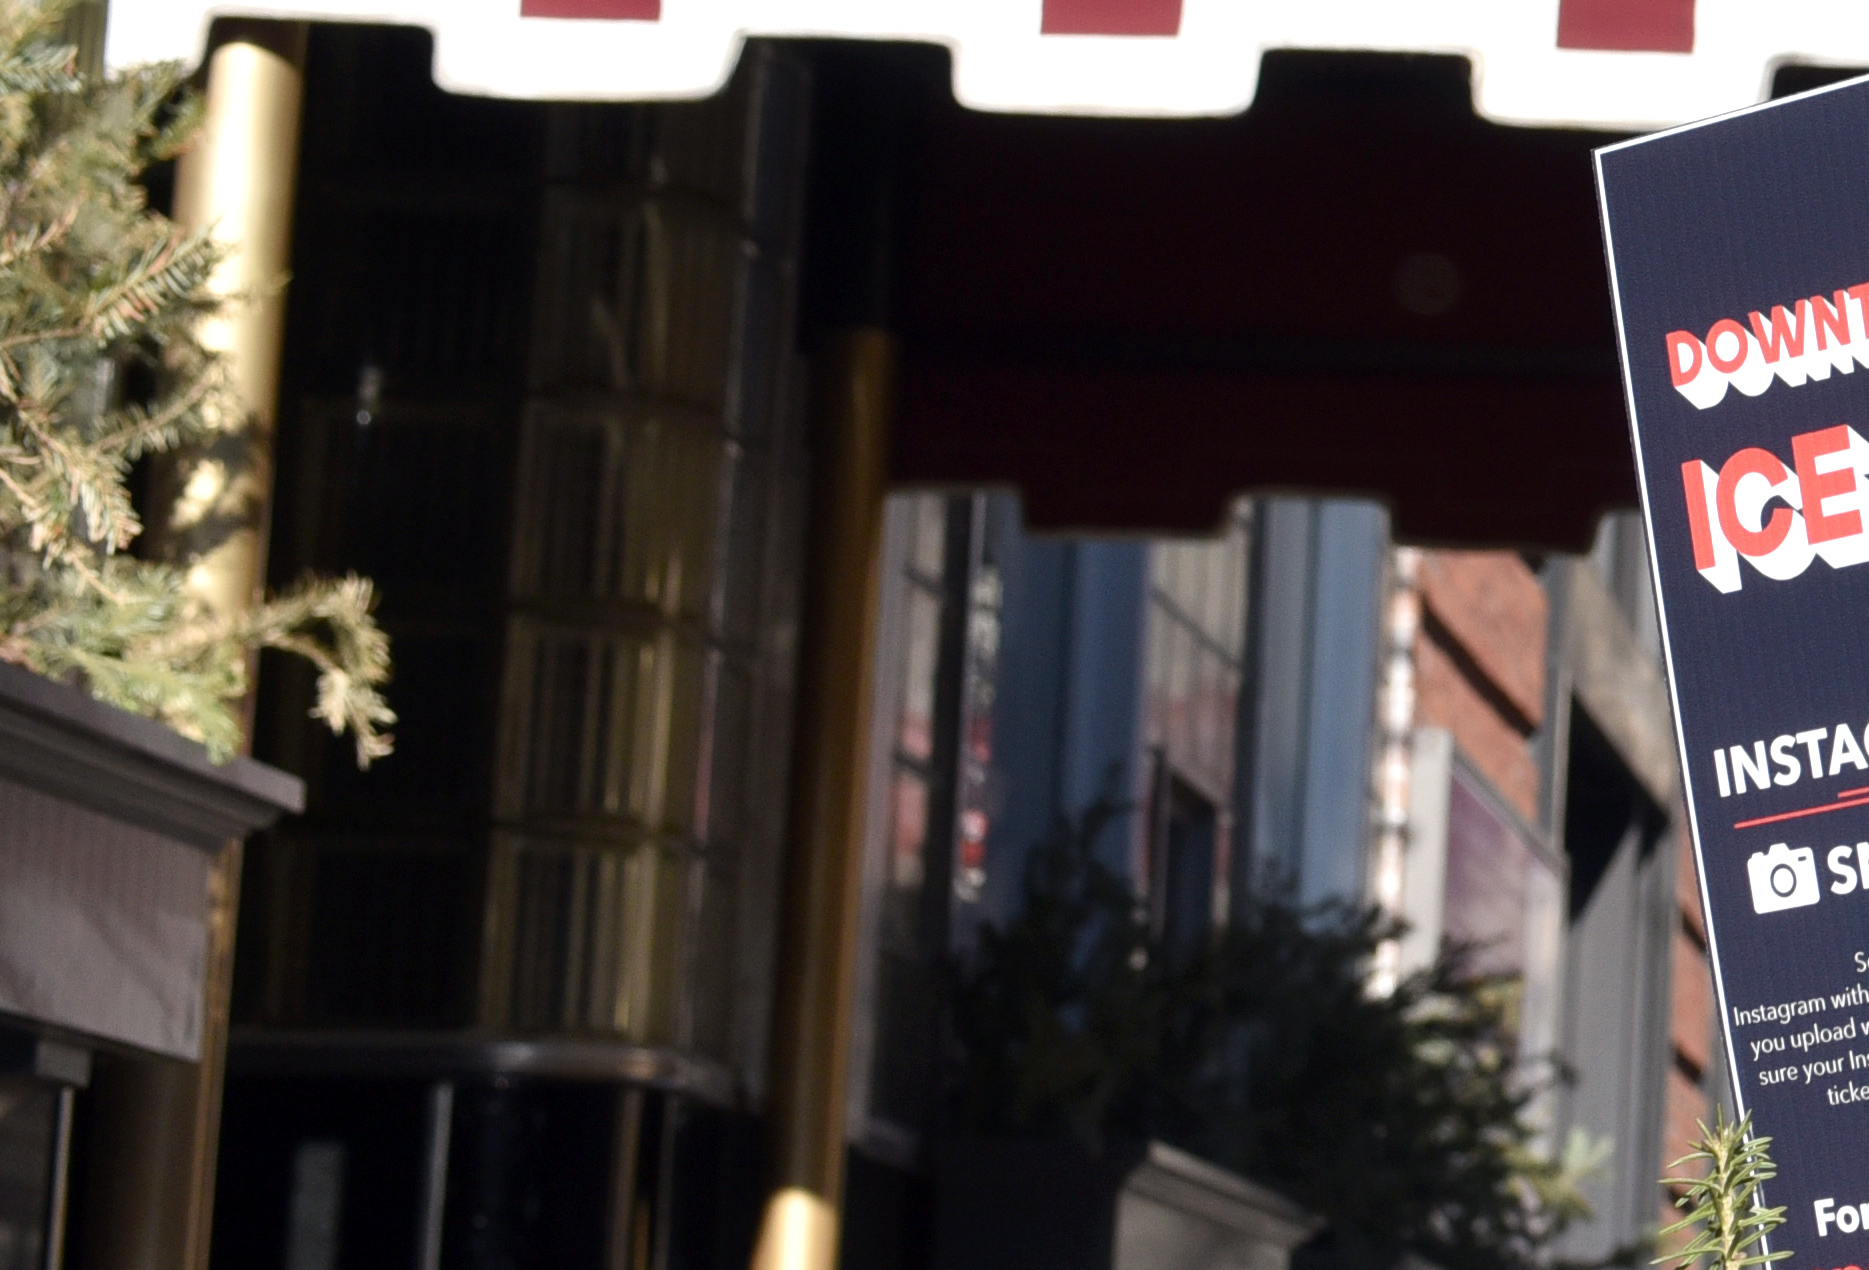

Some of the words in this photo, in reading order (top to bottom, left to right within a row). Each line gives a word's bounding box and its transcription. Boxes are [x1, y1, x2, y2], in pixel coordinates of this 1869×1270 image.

[1732, 996, 1826, 1026] Instagram
[1829, 982, 1869, 1009] with
[1749, 1035, 1786, 1060] you
[1789, 1015, 1857, 1051] upload
[1757, 1065, 1798, 1086] sure
[1801, 1056, 1844, 1082] your
